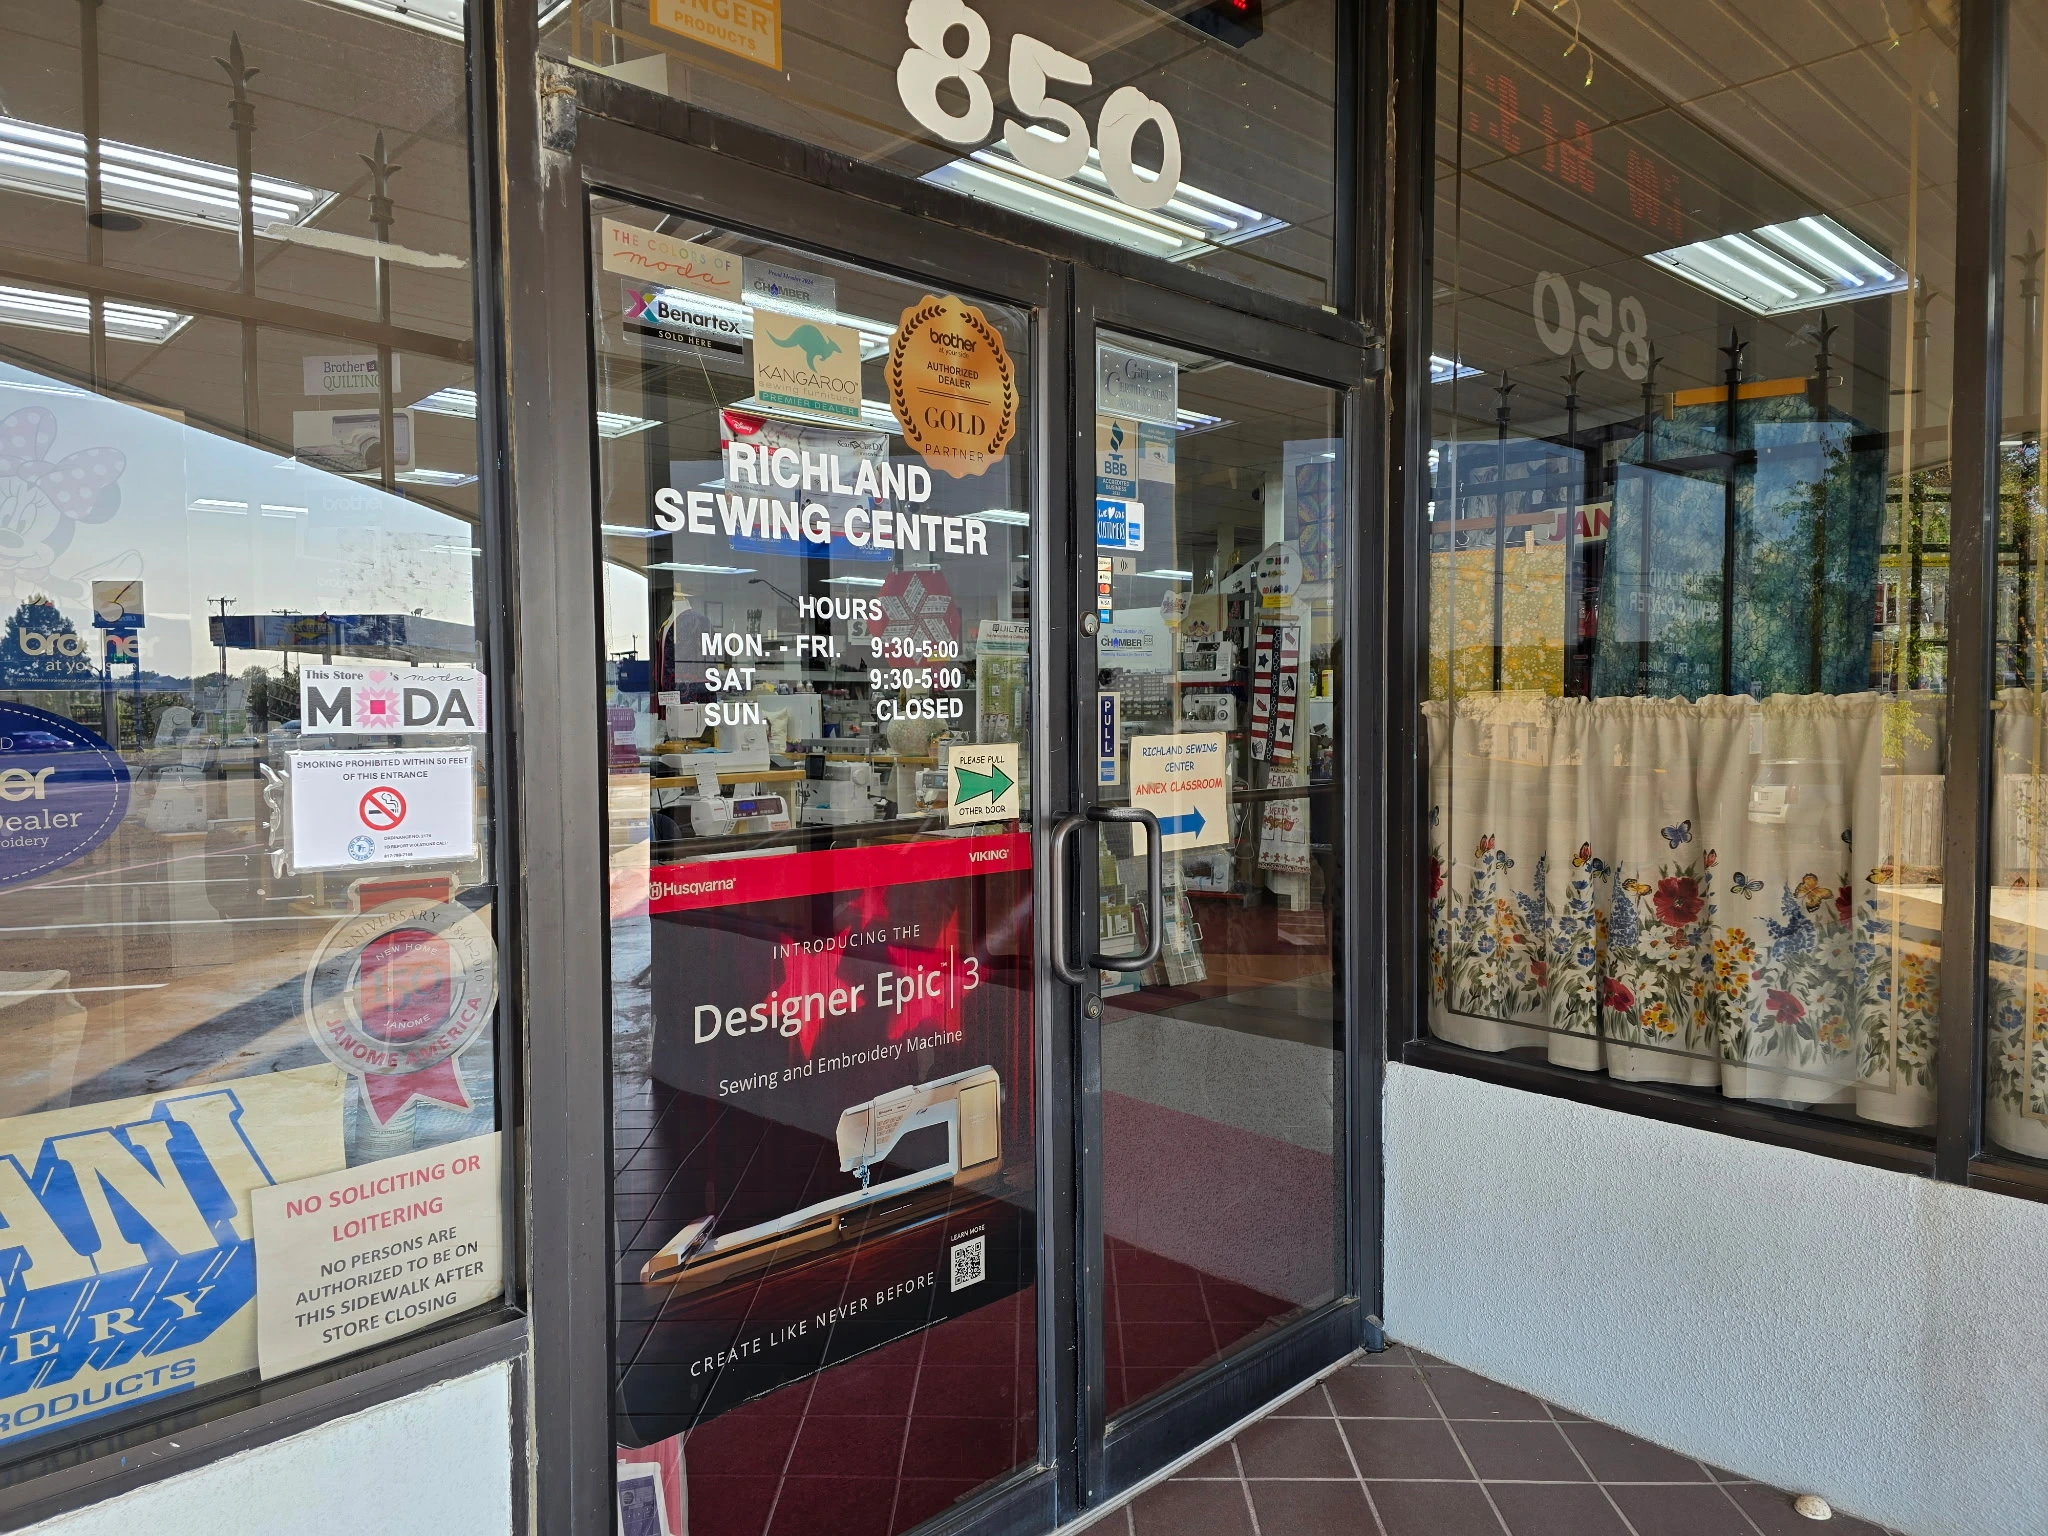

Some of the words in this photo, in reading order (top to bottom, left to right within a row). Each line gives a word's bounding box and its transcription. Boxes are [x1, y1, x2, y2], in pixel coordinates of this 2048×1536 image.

[674, 10, 757, 51] PRODUCTS
[680, 0, 768, 36] NGER
[896, 0, 1182, 211] 850
[613, 228, 639, 246] THE
[648, 239, 706, 265] COLORS
[714, 257, 731, 272] OF
[613, 251, 731, 286] moda
[658, 300, 741, 335] Benartex
[658, 329, 684, 343] SOLD
[688, 336, 712, 348] HERE
[930, 327, 977, 353] brother
[324, 361, 365, 373] Brother
[926, 361, 979, 380] AUTHORIZED
[758, 381, 799, 396] sewing
[803, 387, 855, 404] furniture
[938, 375, 971, 390] DEALER
[762, 392, 810, 408] PREMIER
[814, 401, 855, 416] DEALER
[924, 406, 986, 436] GOLD
[925, 443, 984, 463] PARTNER
[729, 441, 932, 503] RICHLAND
[1104, 460, 1128, 476] BBB
[655, 488, 831, 545] SEWING
[844, 512, 988, 556] CENTER
[799, 595, 883, 621] HOURS
[19, 627, 159, 656] broher
[701, 632, 771, 657] MON.
[796, 634, 841, 658] FRI.
[871, 637, 959, 658] 9:30-5:00
[46, 660, 61, 671] at
[305, 669, 330, 680] This
[333, 671, 364, 681] Store
[404, 673, 474, 682] moda
[705, 668, 756, 692] SAT
[870, 668, 962, 690] 9:30-5:00
[704, 702, 767, 727] SUN.
[876, 697, 964, 721] CLOSED
[1104, 701, 1113, 753] PULL
[960, 756, 986, 765] PLEASE
[987, 755, 1005, 764] PULL
[1142, 744, 1183, 757] RICHLAND
[1185, 742, 1217, 755] SEWING
[297, 760, 343, 769] SMOKING
[345, 759, 400, 768] PROHIBITED
[402, 758, 436, 767] WITHIN
[437, 757, 447, 765] 50
[448, 757, 468, 765] FEET
[343, 773, 356, 781] OF
[358, 772, 378, 781] THIS
[380, 770, 429, 780] ENTRANCE
[1165, 761, 1194, 773] CENTER
[1136, 782, 1167, 796] ANNEX
[1170, 777, 1223, 793] CLASSROOM
[0, 809, 83, 832] ealer
[959, 807, 983, 816] OTHER
[985, 805, 1006, 815] DOOR
[663, 877, 734, 897] Husqvarna
[969, 849, 1008, 863] VIKING
[375, 945, 400, 961] NEW
[405, 943, 438, 955] HOME
[773, 929, 887, 961] INTRODUCING
[893, 923, 921, 940] THE
[694, 982, 866, 1045] Designer
[963, 956, 980, 991] 3
[326, 1018, 399, 1068] JANOME
[405, 996, 483, 1066] AMERICA
[383, 1013, 432, 1030] JANOME
[718, 1068, 779, 1098] Sewing
[783, 1060, 813, 1082] and
[817, 1042, 902, 1074] Embroidery
[906, 1027, 963, 1053] Machine
[286, 1195, 322, 1218] NO
[329, 1163, 445, 1208] SOLICITING
[451, 1155, 481, 1175] OR
[333, 1197, 443, 1242] LOITERING
[950, 1229, 968, 1242] LEARN
[969, 1223, 986, 1236] MORE
[321, 1259, 346, 1277] NO
[351, 1236, 423, 1268] PERSONS
[427, 1226, 457, 1246] ARE
[295, 1264, 403, 1306] AUTHORIZED
[407, 1256, 428, 1273] TO
[433, 1249, 451, 1265] BE
[455, 1241, 478, 1257] ON
[295, 1305, 336, 1328] THIS
[340, 1276, 430, 1315] SIDEWALK
[434, 1261, 484, 1287] AFTER
[322, 1315, 379, 1344] STORE
[384, 1291, 457, 1323] CLOSING
[690, 1336, 761, 1377] CREATE
[769, 1319, 808, 1347] LIKE
[815, 1296, 868, 1329] NEVER
[876, 1270, 936, 1306] BEFORE
